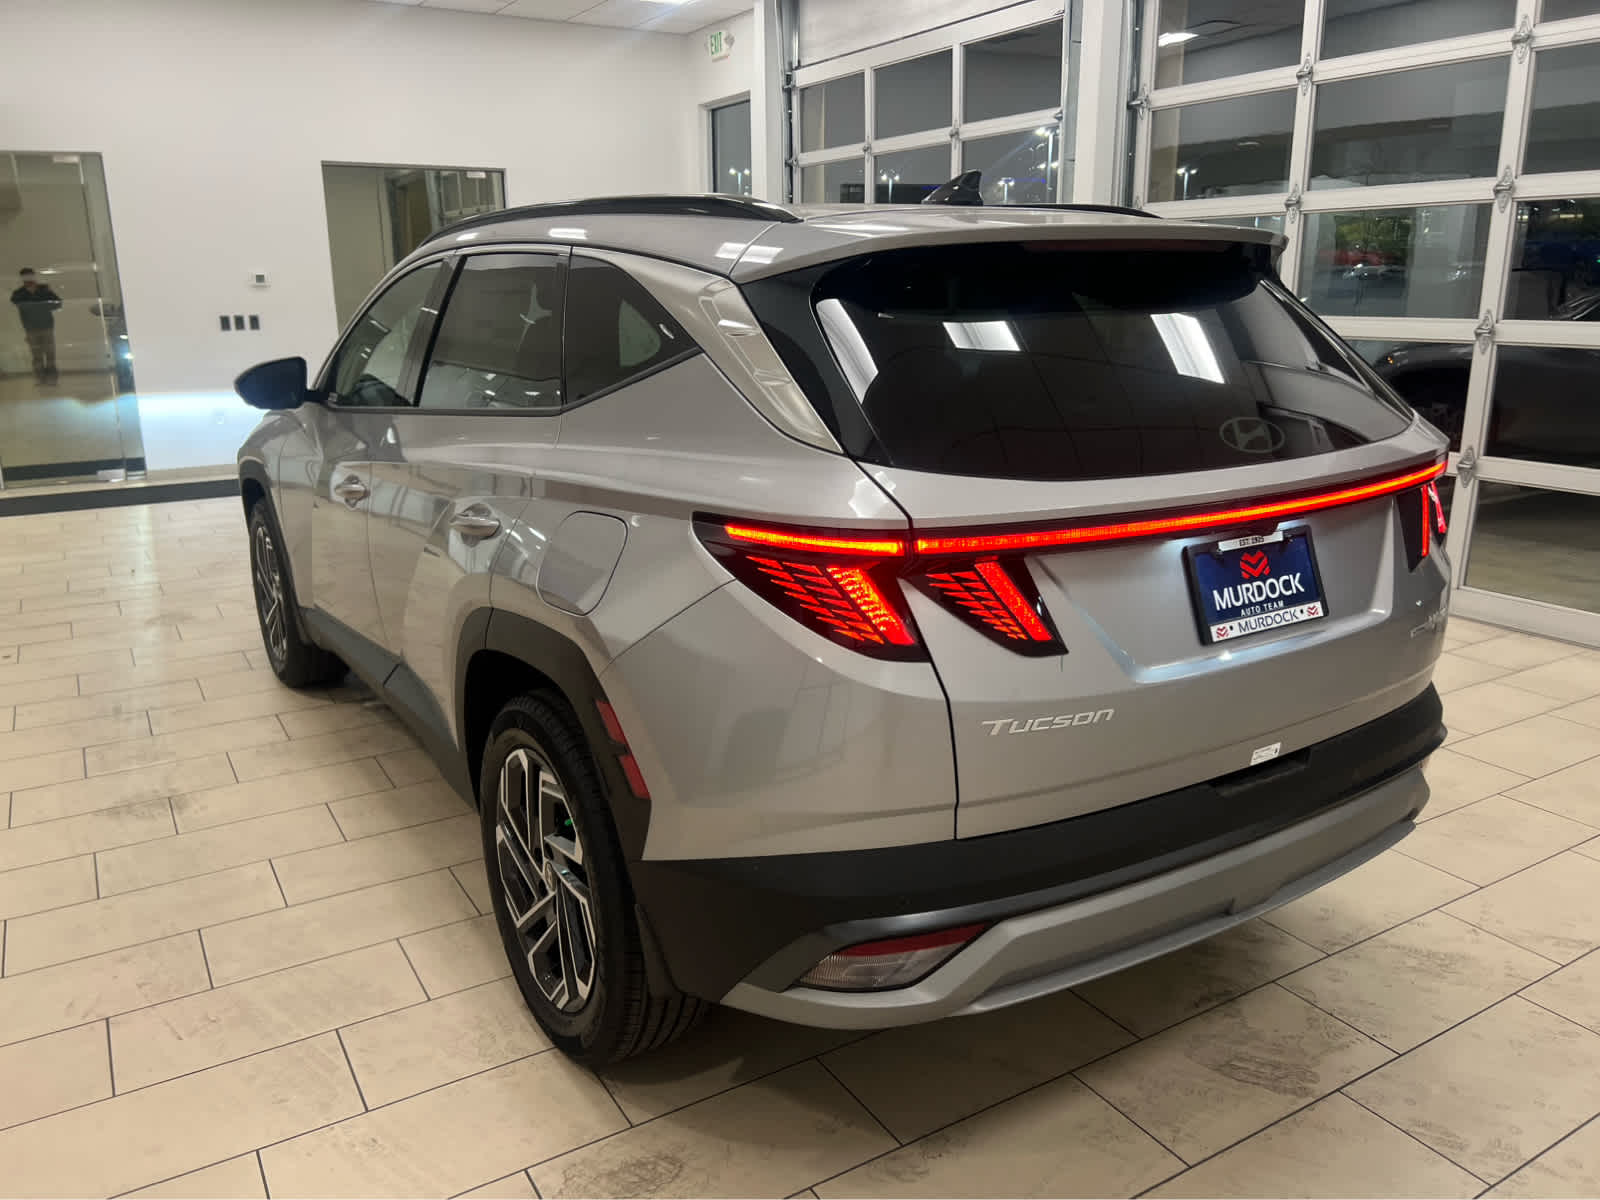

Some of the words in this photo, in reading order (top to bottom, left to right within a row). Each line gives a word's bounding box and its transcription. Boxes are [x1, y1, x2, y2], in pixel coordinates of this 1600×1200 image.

[710, 31, 722, 55] EXIT
[1212, 572, 1305, 611] MURDOCK
[1240, 605, 1261, 617] AUTO
[1263, 600, 1285, 612] TEAM
[1238, 609, 1299, 634] MURDOCK
